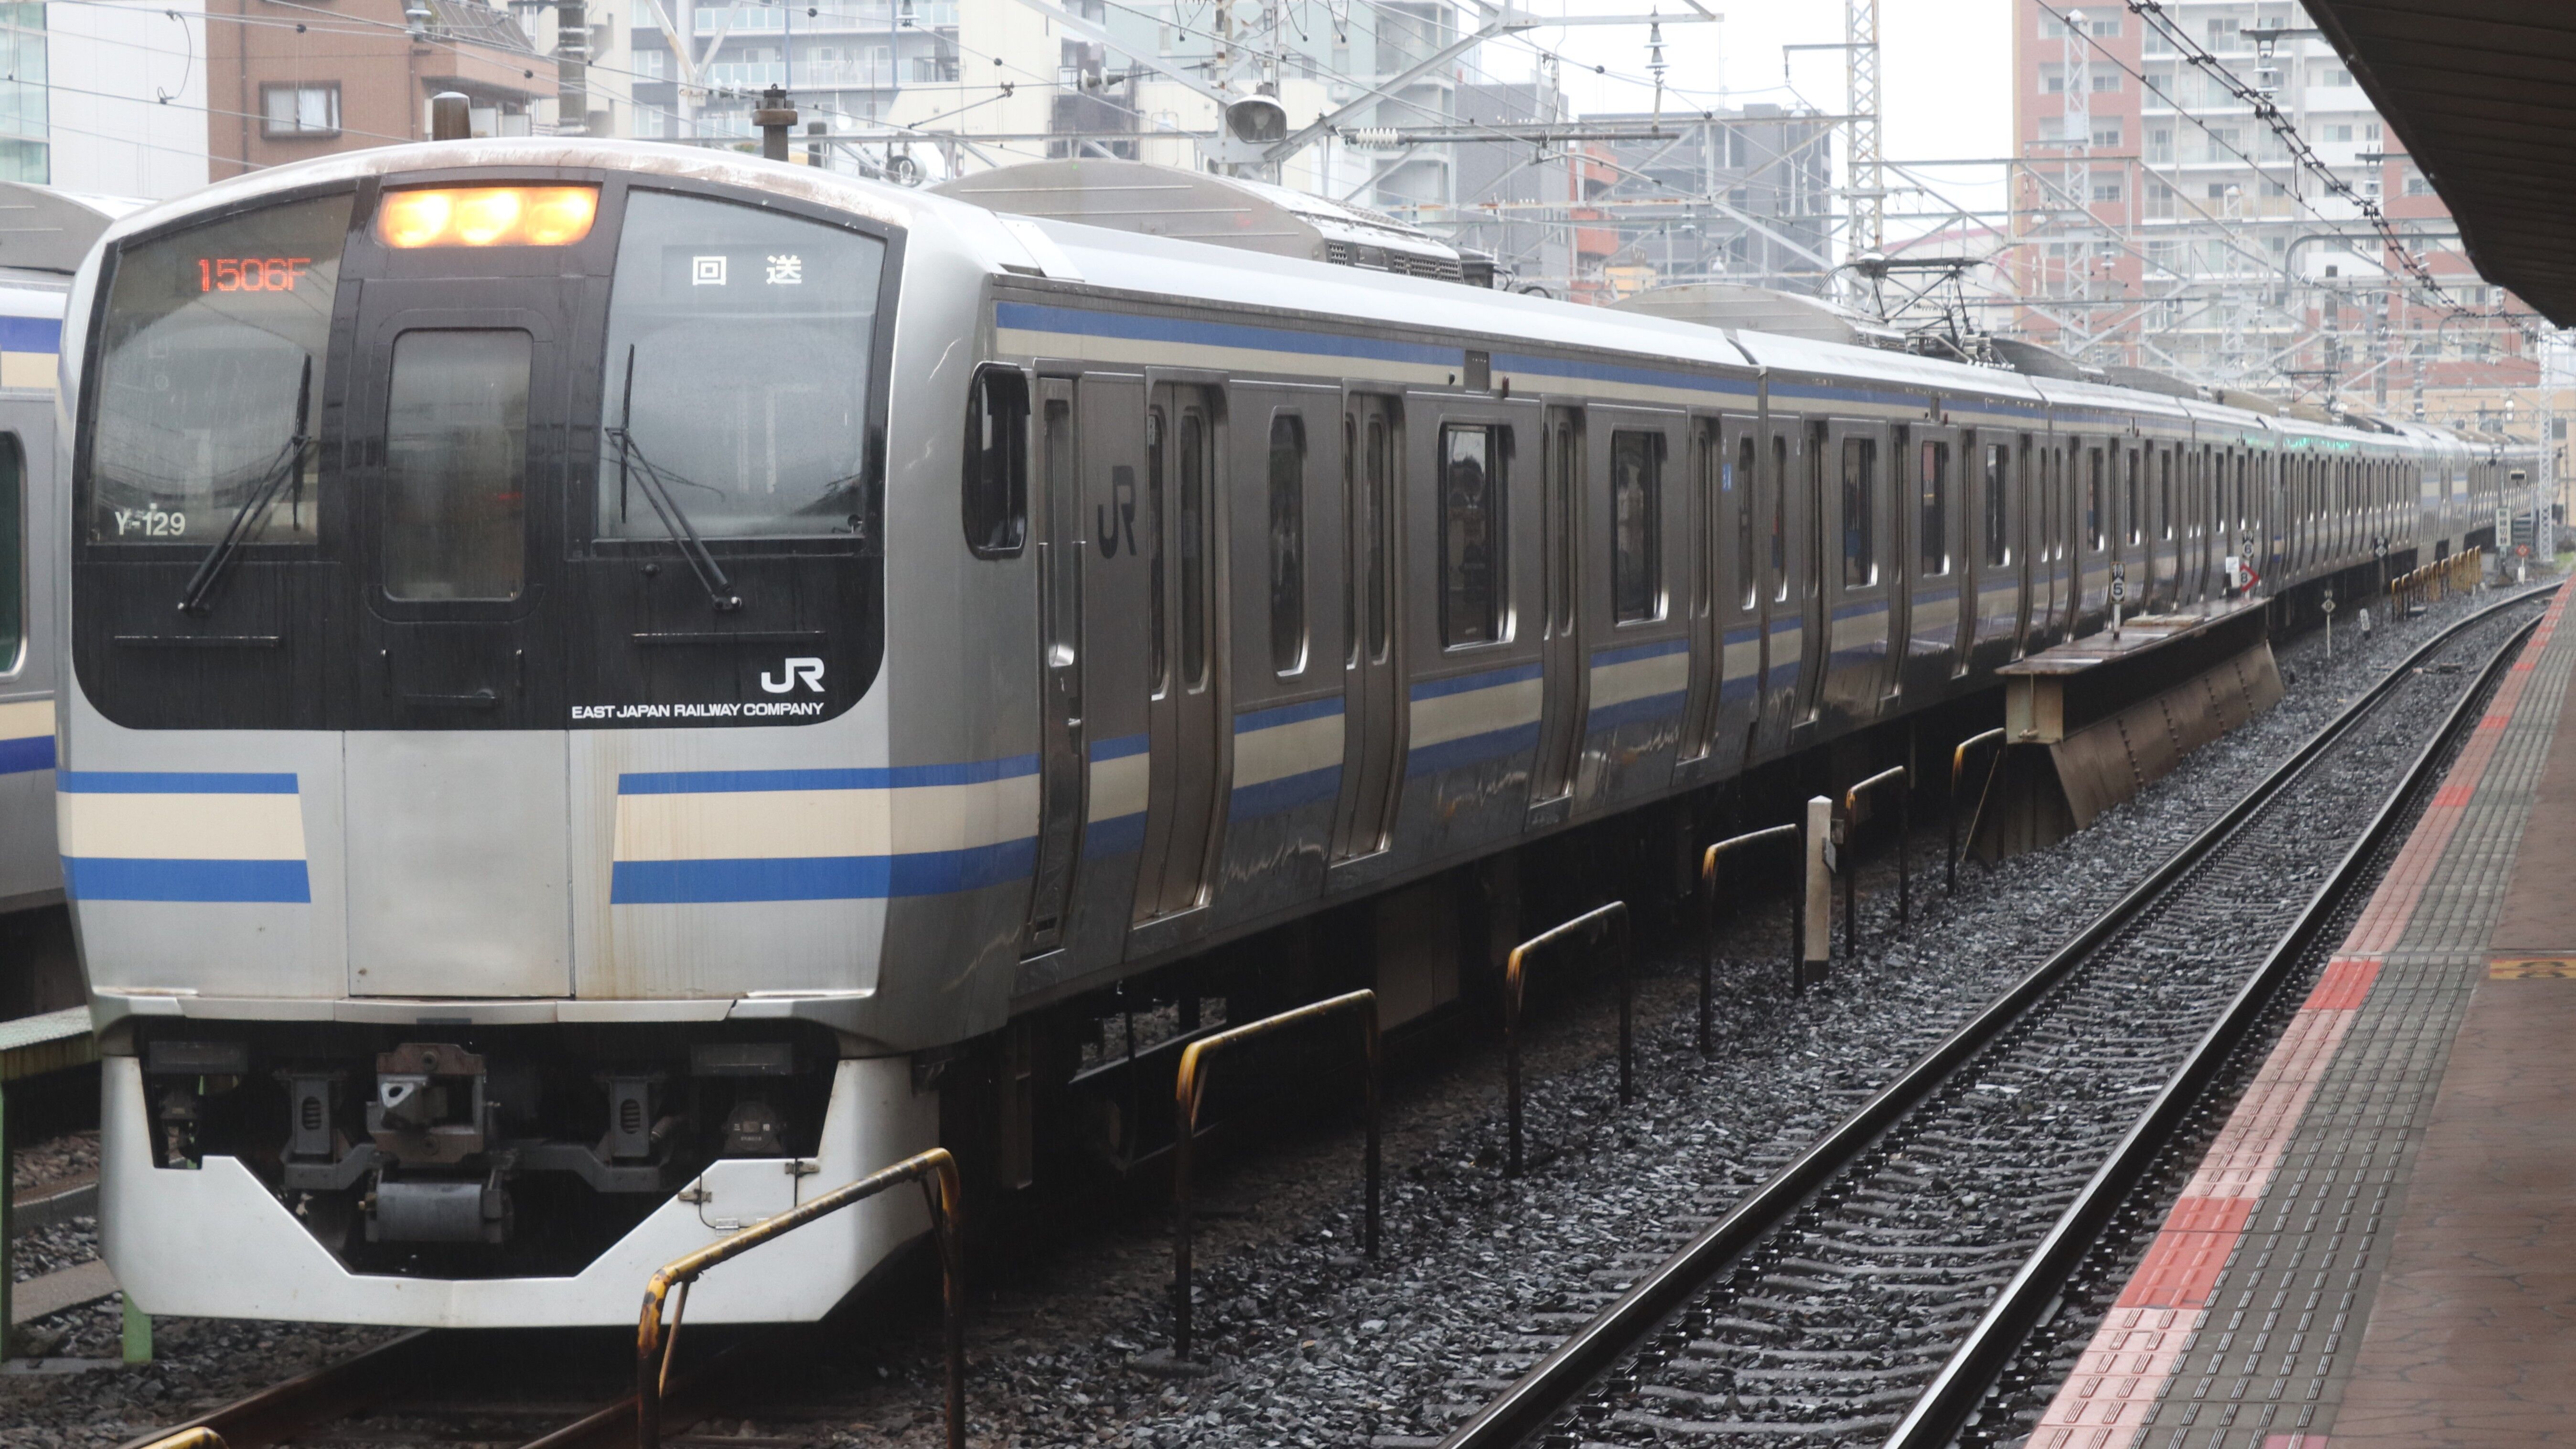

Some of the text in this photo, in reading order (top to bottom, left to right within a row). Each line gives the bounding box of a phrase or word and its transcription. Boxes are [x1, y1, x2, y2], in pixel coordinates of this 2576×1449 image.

[199, 258, 311, 291] 1506F
[692, 255, 802, 286] 回送
[115, 512, 185, 536] Y-129
[1097, 465, 1137, 559] JR
[2114, 583, 2123, 596] 5
[761, 657, 825, 693] JR
[572, 702, 824, 719] EAST JAPAN RAILWAY COMPANY
